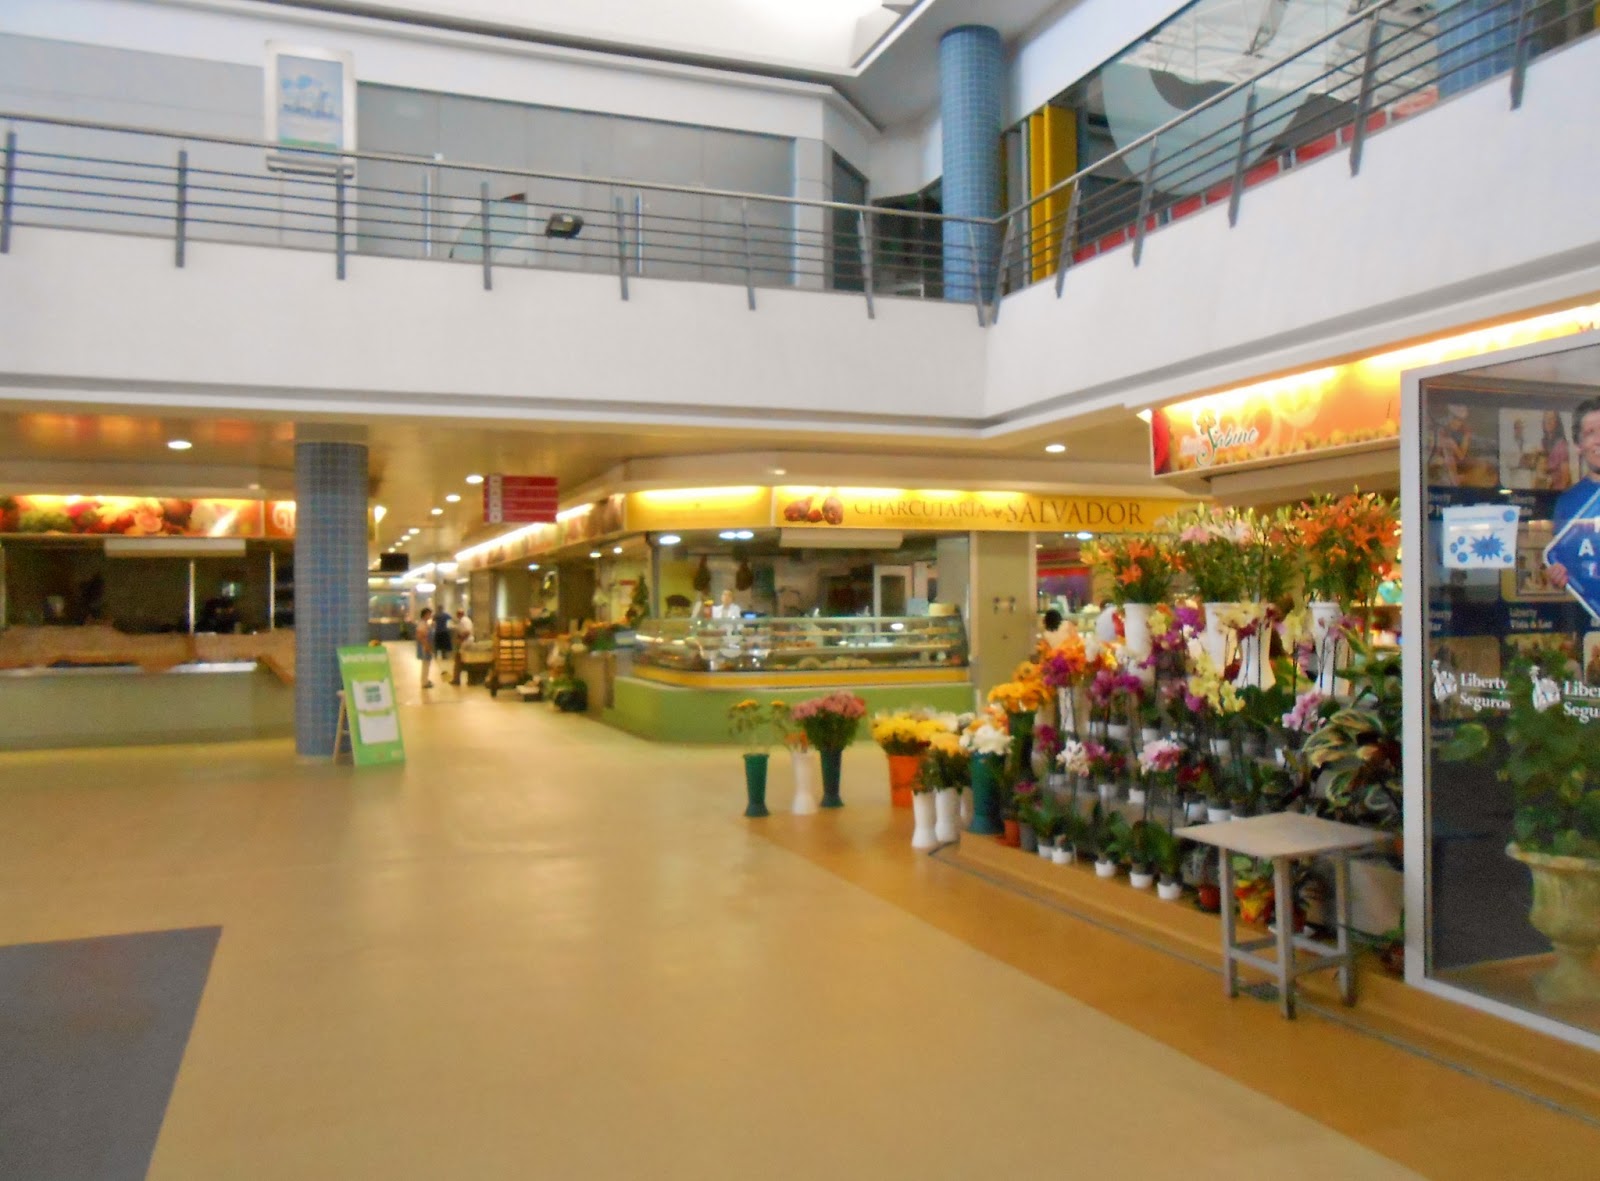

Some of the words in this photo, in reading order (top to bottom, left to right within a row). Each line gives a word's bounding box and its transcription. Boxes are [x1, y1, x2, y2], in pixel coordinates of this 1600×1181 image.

[854, 500, 987, 518] CHARCUTARIA
[1006, 500, 1144, 525] SALVADOR
[1460, 673, 1508, 690] Liberty
[1460, 692, 1511, 712] Seguros
